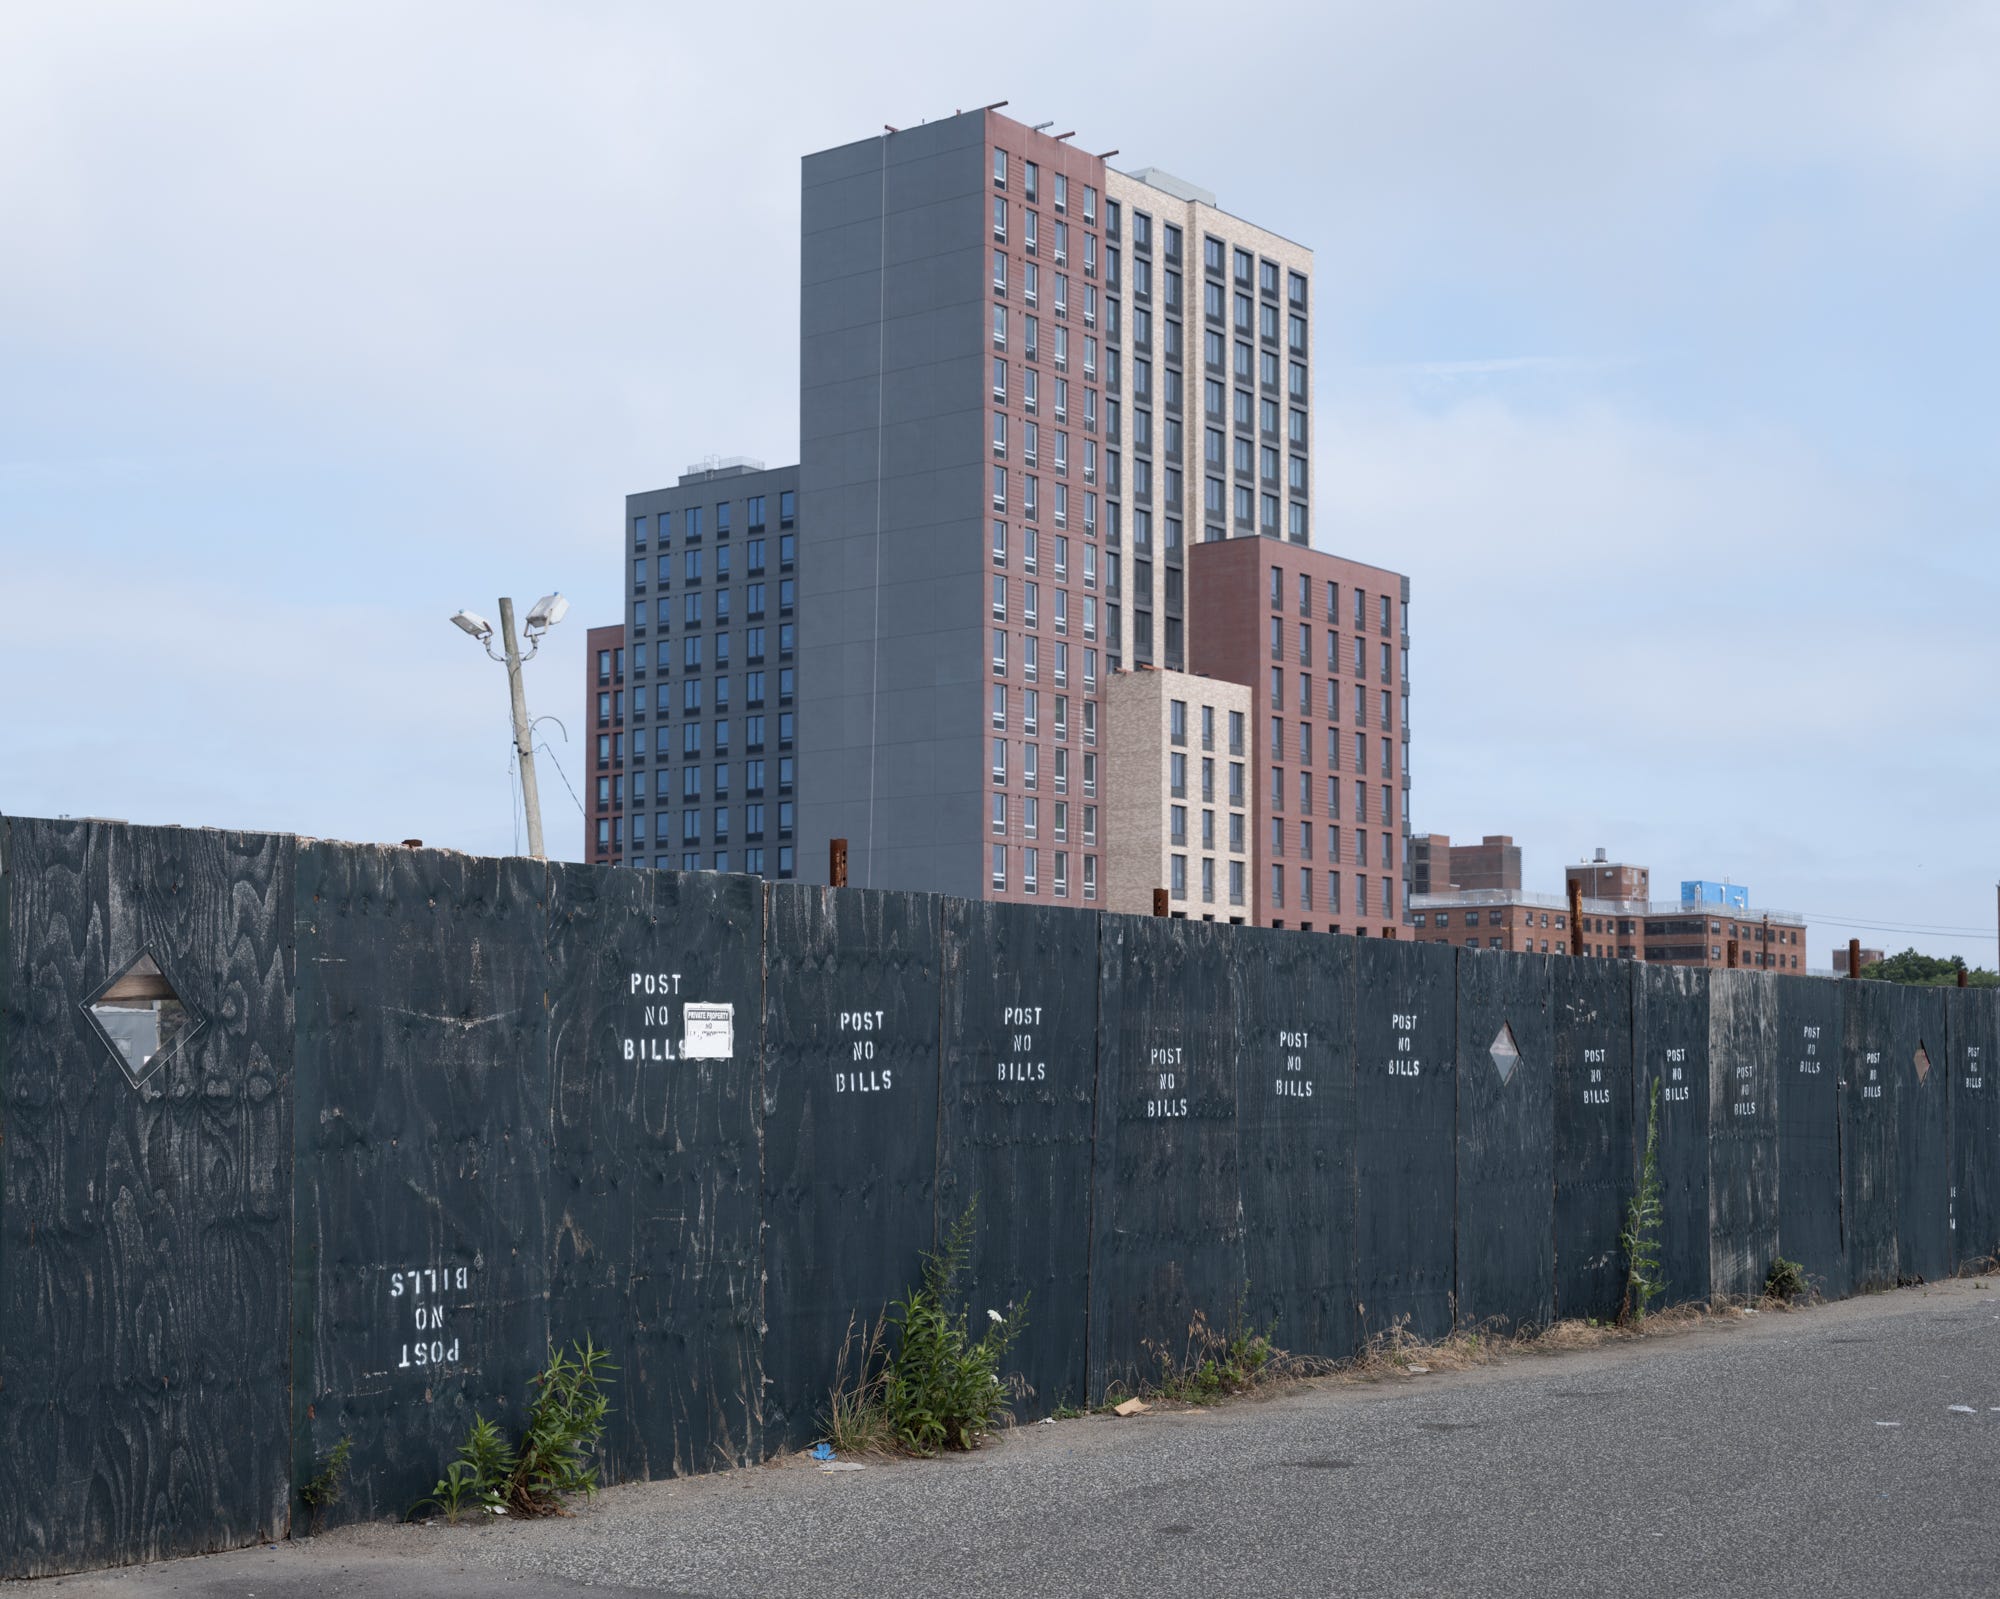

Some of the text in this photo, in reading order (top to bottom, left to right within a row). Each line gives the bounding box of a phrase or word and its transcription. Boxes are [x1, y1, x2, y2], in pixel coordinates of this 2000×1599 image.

[631, 973, 681, 995] POST
[644, 1005, 669, 1026] NO
[840, 1010, 884, 1031] POST
[1004, 1007, 1042, 1025] POST
[1392, 1014, 1417, 1030] POST
[1279, 1031, 1308, 1048] POST
[1803, 1025, 1821, 1039] POST
[853, 1040, 874, 1061] NO
[1013, 1034, 1032, 1052] NO
[1398, 1036, 1410, 1052] NO
[1150, 1047, 1182, 1065] POST
[1287, 1055, 1302, 1072] NO
[1584, 1049, 1606, 1063] POST
[1666, 1049, 1685, 1063] POST
[1866, 1052, 1881, 1064] POST
[998, 1062, 1046, 1081] BILLS
[1388, 1059, 1420, 1077] BILLS
[1673, 1067, 1682, 1080] NO
[1736, 1065, 1753, 1080] POST
[1799, 1060, 1821, 1074] BILLS
[835, 1069, 892, 1093] BILLS
[1159, 1072, 1175, 1090] NO
[1590, 1069, 1602, 1083] NO
[1276, 1079, 1313, 1098] BILLS
[1583, 1089, 1610, 1104] BILLS
[1665, 1087, 1689, 1101] BILLS
[1863, 1085, 1882, 1098] BILLS
[1147, 1098, 1187, 1118] BILLS
[1734, 1102, 1756, 1116] BILLS
[390, 1266, 468, 1297] BILLS
[415, 1304, 444, 1331] NO
[398, 1337, 459, 1368] POST
